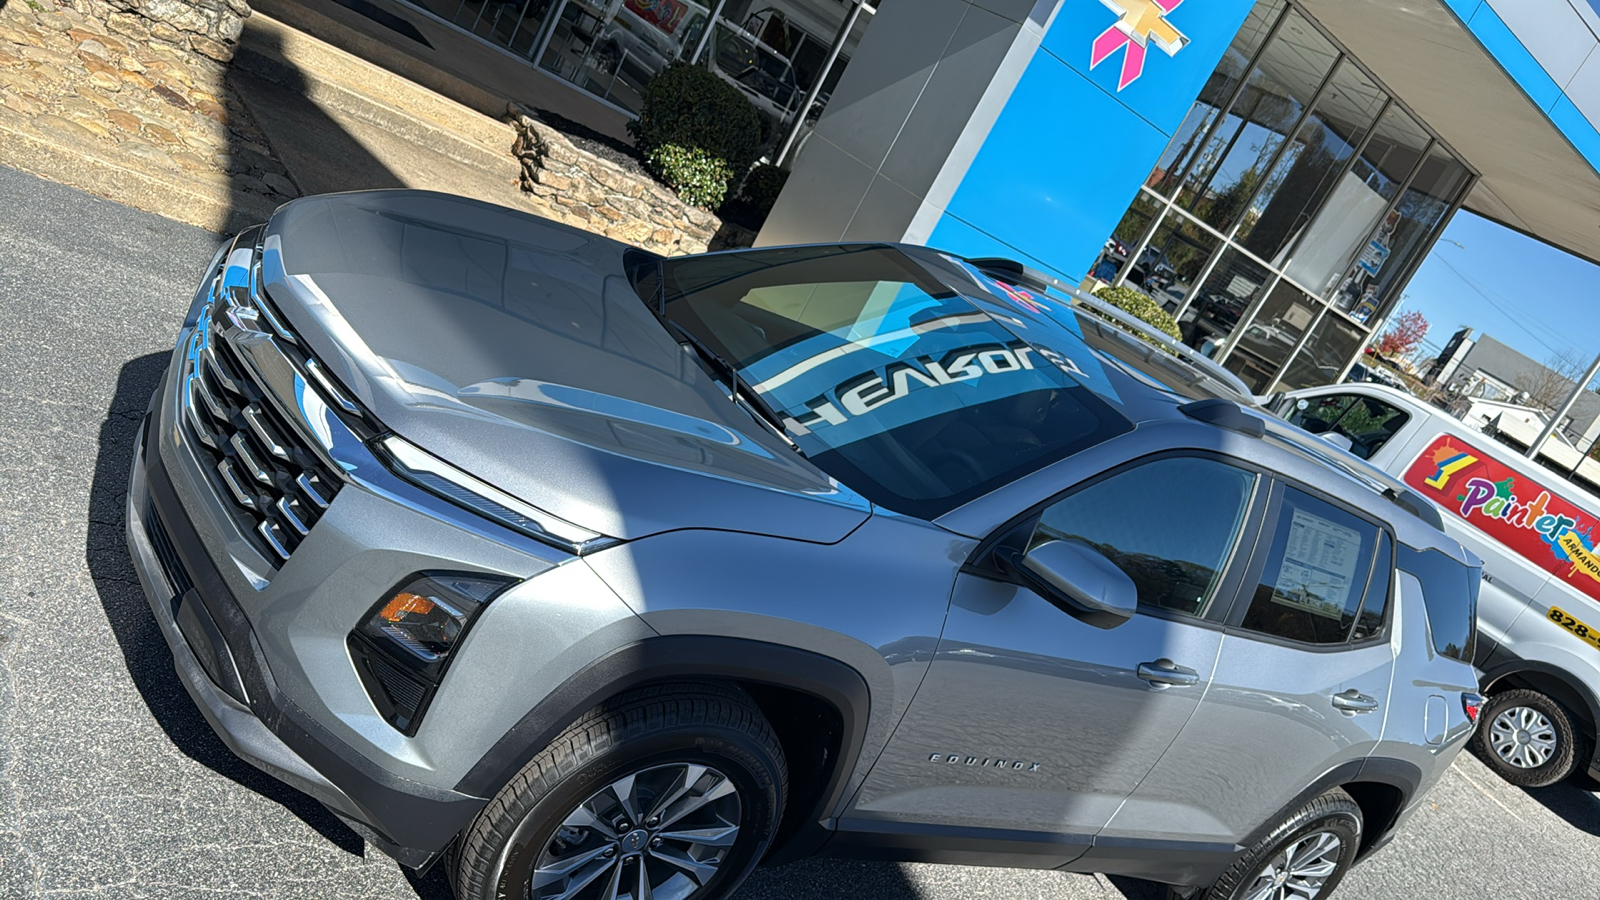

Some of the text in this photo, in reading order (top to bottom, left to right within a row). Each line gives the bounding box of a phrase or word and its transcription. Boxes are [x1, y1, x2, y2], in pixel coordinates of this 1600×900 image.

[1460, 477, 1577, 542] Painter
[1549, 609, 1600, 648] 828-
[928, 752, 1041, 773] EQUINOX
